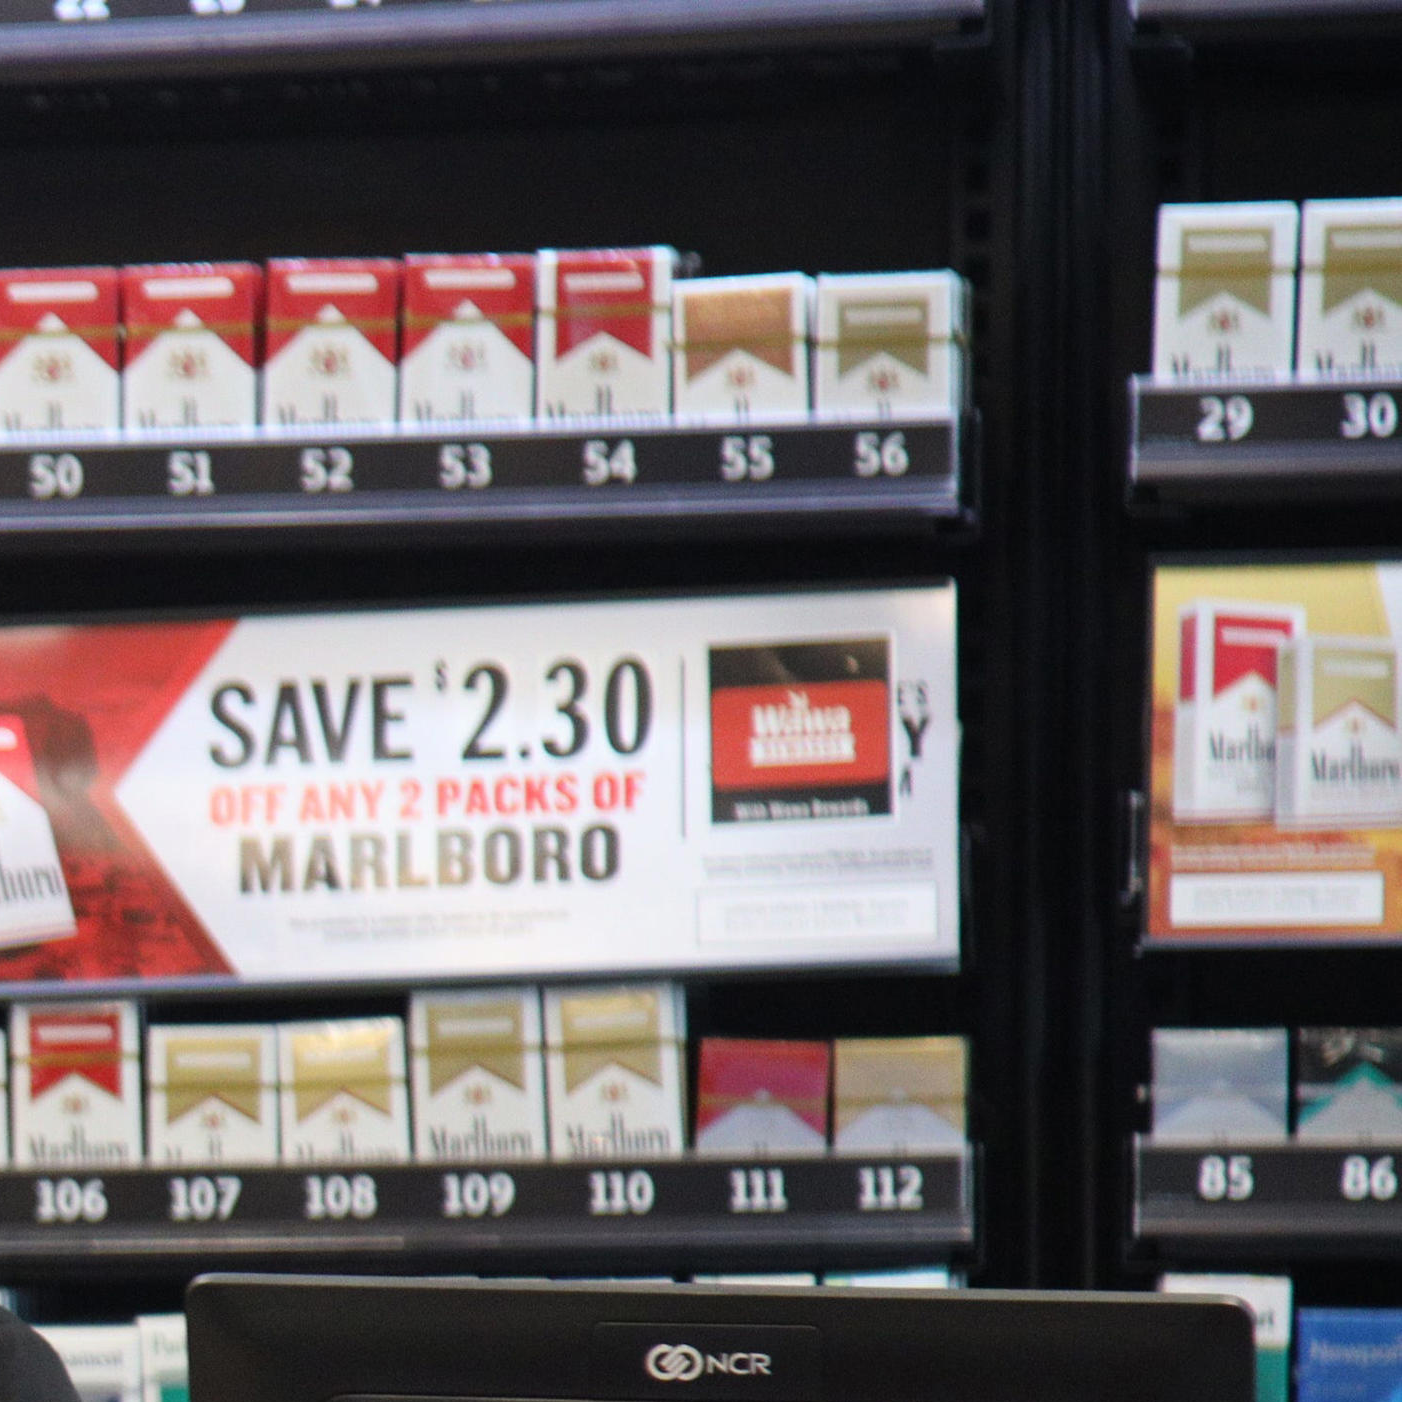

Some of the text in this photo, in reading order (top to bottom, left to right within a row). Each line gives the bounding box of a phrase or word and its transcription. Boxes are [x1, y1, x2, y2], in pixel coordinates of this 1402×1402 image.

[1196, 393, 1398, 442] 29 30
[28, 453, 84, 499] 50
[168, 451, 214, 496] 51
[301, 447, 354, 493] 52
[439, 443, 493, 490] 53
[584, 439, 637, 486] 54
[721, 435, 775, 482] 55
[854, 431, 909, 478] 56
[209, 676, 414, 769] SAVE
[210, 770, 645, 827] OFF ANY 2 PACKS OF
[239, 823, 622, 894] MARLBORO
[36, 1178, 107, 1222] 106
[170, 1176, 242, 1221] 107
[304, 1174, 377, 1219] 108
[443, 1172, 516, 1217] 109
[588, 1170, 655, 1214] 110
[729, 1168, 788, 1213] 111
[858, 1166, 923, 1211] 112
[1198, 1156, 1397, 1200] 85 86
[706, 1353, 772, 1376] NCR
